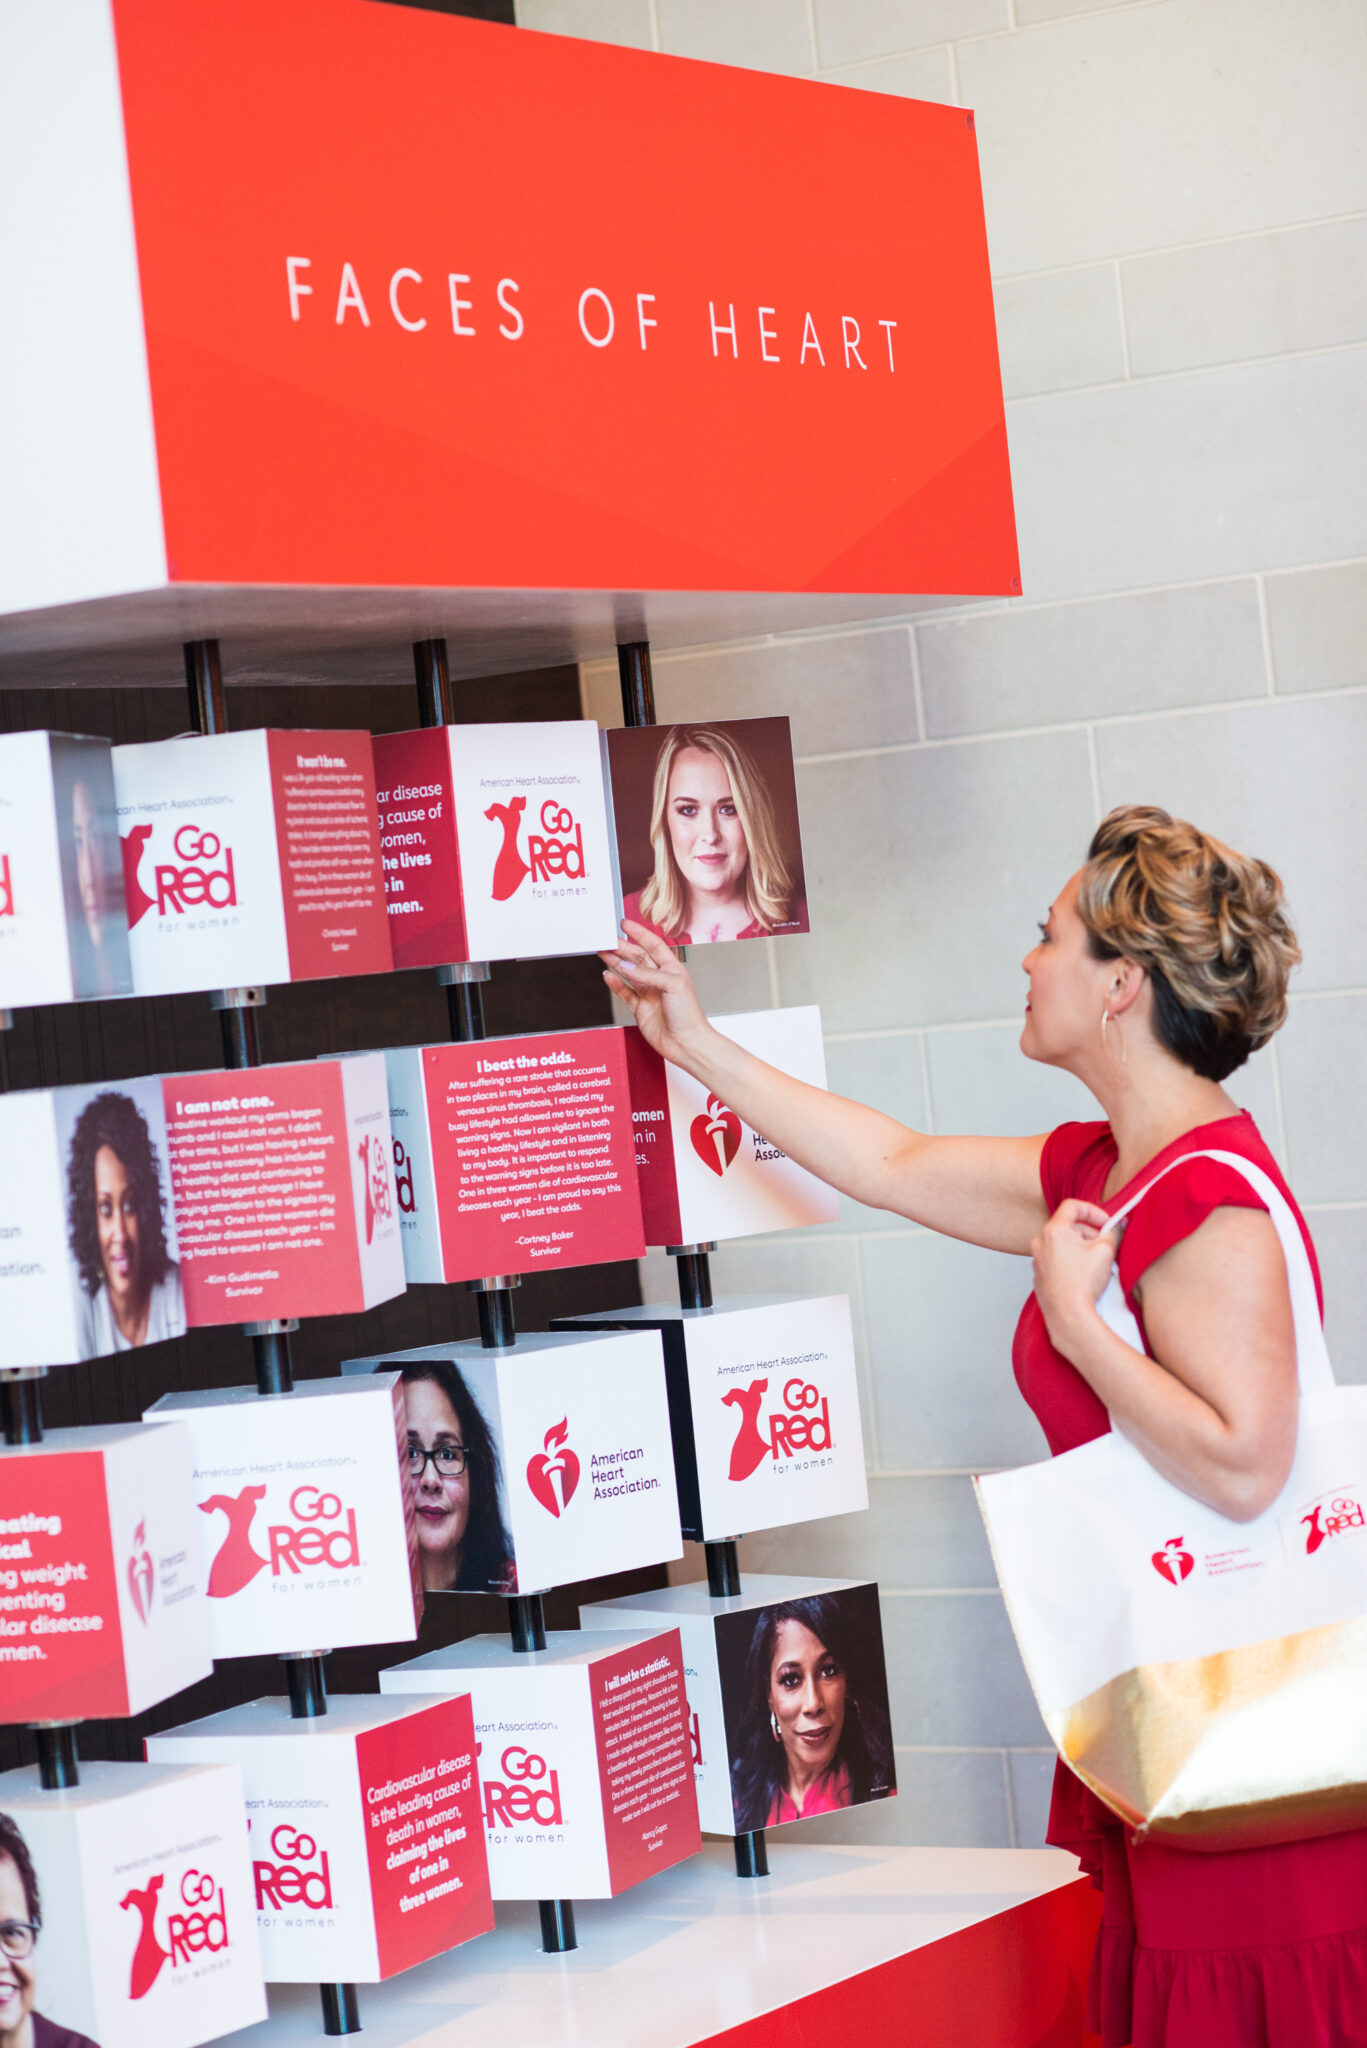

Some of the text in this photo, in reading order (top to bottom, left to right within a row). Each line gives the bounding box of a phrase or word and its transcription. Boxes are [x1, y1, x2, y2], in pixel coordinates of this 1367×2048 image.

[286, 256, 898, 373] FACES OF HEART
[376, 783, 442, 803] ar disease
[480, 777, 514, 787] American
[515, 776, 537, 786] Heart
[138, 801, 168, 812] Heart
[387, 810, 426, 824] cause
[428, 802, 443, 819] of
[540, 799, 573, 835] Go
[174, 824, 221, 861] Go
[527, 823, 586, 883] Red
[400, 851, 433, 868] lives
[155, 847, 237, 916] Red
[391, 876, 405, 892] in
[532, 886, 588, 898] for women
[158, 916, 240, 932] for women
[476, 1050, 576, 1074] I beat the odds.
[448, 1063, 607, 1090] After suffering a rare stroke that occurred
[446, 1076, 612, 1104] in two places in my brain, called a cerebral
[175, 1095, 275, 1116] I am not one.
[447, 1103, 615, 1132] busy lifestyle had allowed me to ignore the
[456, 1092, 604, 1117] venous sinus thrombosis, I realized my
[455, 1117, 610, 1144] warning signs. Now I am vigilant in both
[645, 1129, 656, 1143] in
[514, 1230, 574, 1245] -Cortney Baker
[529, 1246, 562, 1257] Survivor
[224, 1286, 263, 1298] Survivor
[716, 1363, 755, 1376] American
[756, 1358, 780, 1369] Heart
[783, 1378, 819, 1412] Go
[768, 1397, 832, 1460] Red
[192, 1466, 248, 1480] American
[250, 1461, 283, 1474] Heart
[590, 1448, 644, 1468] American
[773, 1456, 834, 1474] for women
[591, 1466, 625, 1484] Heart
[289, 1485, 342, 1522] Go
[1331, 1498, 1354, 1514] Go
[1325, 1503, 1366, 1538] Red
[268, 1508, 360, 1576] Red
[20, 1561, 88, 1587] weight
[272, 1576, 362, 1593] for women
[30, 1615, 104, 1635] disease
[604, 1679, 609, 1693] I
[607, 1674, 621, 1691] will
[619, 1671, 632, 1686] not
[630, 1668, 640, 1682] be
[638, 1667, 645, 1678] a
[643, 1655, 671, 1676] statistic.
[501, 1746, 547, 1781] Go
[366, 1752, 471, 1805] Cardiovascular disease
[370, 1771, 472, 1828] is the leading cause of
[483, 1769, 563, 1829] Red
[385, 1805, 462, 1846] death in women,
[488, 1833, 565, 1844] for women
[271, 1824, 317, 1861] Go
[385, 1826, 467, 1870] claiming the lives
[647, 1839, 663, 1852] Survivor
[252, 1850, 333, 1910] Red
[408, 1855, 449, 1885] of one in
[180, 1868, 215, 1907] Go
[399, 1876, 464, 1913] three women.
[168, 1887, 229, 1968] Red
[257, 1915, 335, 1928] for women
